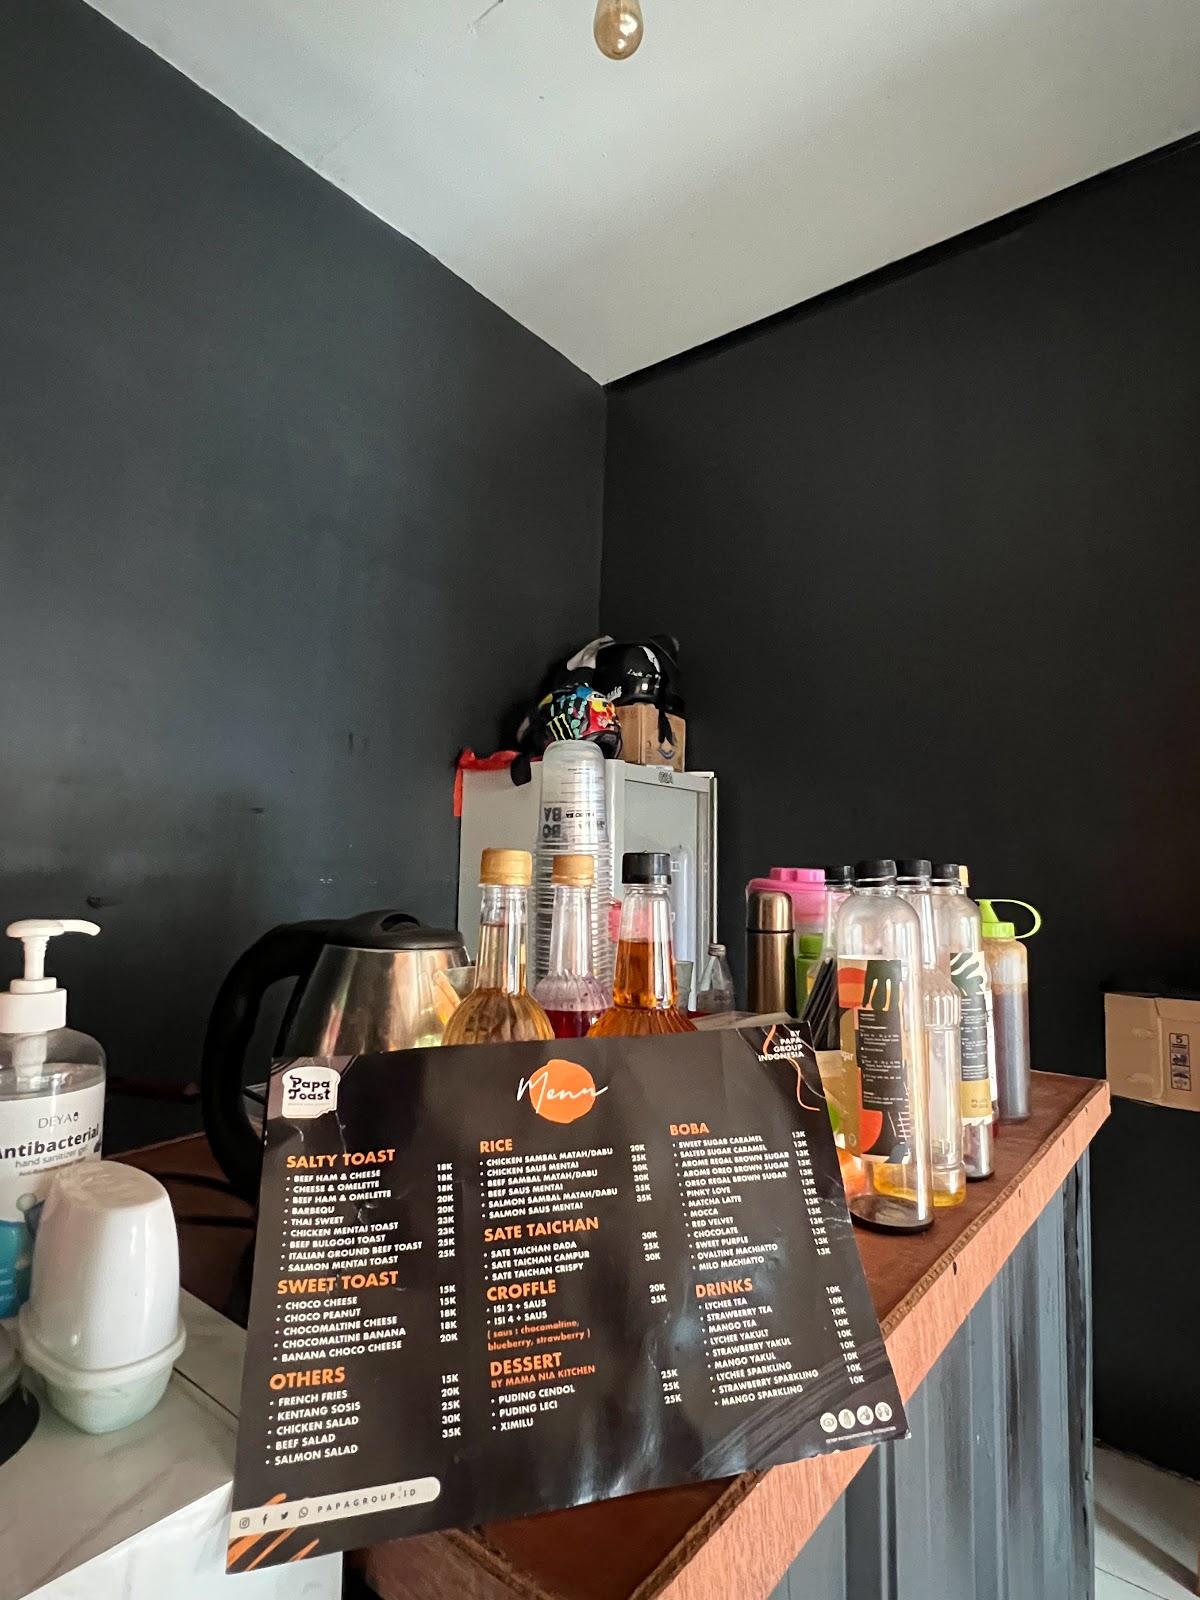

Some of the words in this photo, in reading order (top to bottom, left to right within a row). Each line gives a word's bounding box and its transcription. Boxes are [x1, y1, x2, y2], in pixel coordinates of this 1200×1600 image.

[773, 1044, 802, 1052] GROUP
[758, 1051, 804, 1061] INDONESIA
[290, 1075, 330, 1092] Papa
[288, 1088, 330, 1100] Toast
[517, 1072, 608, 1114] Menu
[38, 1114, 72, 1128] DEYA
[670, 1123, 709, 1136] BOBA
[0, 1123, 99, 1159] ntibacterial
[480, 1139, 513, 1153] RICE
[287, 1154, 337, 1168] SALTY
[343, 1149, 395, 1166] TOAST
[486, 1157, 522, 1166] CHICKEN
[525, 1154, 557, 1164] SAMBAL
[559, 1148, 613, 1160] MATAH/DABU
[680, 1150, 705, 1158] SALTED
[707, 1148, 732, 1156] SUGAR
[733, 1145, 767, 1153] CARAMEL
[350, 1170, 381, 1179] CHEESE
[338, 1181, 379, 1191] OMELETTE
[687, 1189, 710, 1197] PINKY
[712, 1187, 730, 1195] LOVE
[689, 1198, 720, 1207] MATCHA
[722, 1196, 741, 1204] LATTE
[292, 1206, 335, 1214] BARBEQU
[489, 1209, 526, 1218] SALMON
[528, 1205, 550, 1213] SAUS
[552, 1202, 583, 1211] MENTAI
[690, 1209, 718, 1217] MOCCA
[315, 1216, 344, 1224] SWEET
[709, 1217, 733, 1226] VELVET
[334, 1225, 368, 1235] MENTAI
[370, 1222, 398, 1232] TOAST
[484, 1225, 522, 1242] SATE
[527, 1217, 599, 1236] TAICHAN
[694, 1227, 738, 1238] CHOCOLATE
[313, 1238, 355, 1247] BULGOGI
[358, 1235, 386, 1244] TOAST
[438, 1238, 455, 1247] 25K
[696, 1241, 720, 1249] SWEET
[721, 1236, 748, 1246] PURPLE
[289, 1252, 324, 1260] ITALIAN
[328, 1248, 369, 1258] GROUND
[372, 1246, 392, 1254] BEEF
[394, 1242, 422, 1251] TOAST
[438, 1250, 455, 1258] 25K
[697, 1248, 734, 1260] OVALTINE
[736, 1244, 778, 1255] MACHIATTO
[817, 1248, 831, 1256] 13K
[288, 1263, 329, 1272] SALMON
[332, 1260, 367, 1269] MENTAI
[370, 1256, 398, 1265] TOAST
[492, 1260, 511, 1269] SATE
[514, 1256, 551, 1267] TAICHAN
[554, 1251, 590, 1261] CAMPUR
[699, 1262, 719, 1270] MILO
[721, 1256, 764, 1268] MACHIATTO
[492, 1272, 512, 1281] SATE
[514, 1266, 552, 1278] TAICHAN
[555, 1262, 583, 1273] CRISPY
[278, 1277, 336, 1295] SWEET
[342, 1271, 398, 1289] TOAST
[440, 1285, 456, 1294] 15K
[487, 1279, 556, 1301] CROFFLE
[649, 1283, 665, 1293] 20K
[696, 1278, 753, 1298] DRINKS
[826, 1286, 840, 1294] 10K
[286, 1300, 321, 1310] CHOCO
[324, 1297, 358, 1307] CHEESE
[493, 1304, 505, 1313] ISI
[524, 1299, 546, 1309] SAUS
[651, 1295, 667, 1304] 35K
[705, 1300, 731, 1310] LYCHEE
[734, 1298, 747, 1306] TEA
[829, 1296, 843, 1305] 10K
[284, 1313, 320, 1323] CHOCO
[323, 1308, 361, 1319] PEANUT
[494, 1316, 506, 1325] ISI
[524, 1311, 547, 1320] SAUS
[707, 1308, 757, 1321] STRAWBERRY
[759, 1306, 772, 1314] TEA
[284, 1321, 361, 1335] CHOCOMALTINE
[364, 1316, 397, 1328] CHEESE
[521, 1320, 579, 1334] chocomaltine,
[709, 1323, 741, 1333] MANGO
[744, 1320, 757, 1328] TEA
[834, 1318, 849, 1327] 10K
[283, 1334, 360, 1348] CHOCOMALTINE
[363, 1328, 406, 1340] BANANA
[440, 1334, 458, 1343] 20K
[710, 1335, 738, 1345] LYCHEE
[740, 1329, 768, 1340] YAKULT
[837, 1329, 852, 1338] 10K
[488, 1339, 534, 1351] blueberry,
[536, 1331, 584, 1344] strawberry
[713, 1343, 763, 1357] STRAWBERRY
[765, 1338, 792, 1348] YAKUL
[282, 1350, 326, 1362] BANANA
[329, 1346, 365, 1357] CHOCO
[368, 1341, 402, 1352] CHEESE
[490, 1352, 562, 1377] DESSERT
[715, 1358, 748, 1369] MANGO
[749, 1352, 776, 1363] YAKUL
[491, 1380, 503, 1389] BY
[505, 1375, 536, 1386] MAMA
[538, 1372, 555, 1381] NIA
[558, 1365, 595, 1378] KITCHEN
[661, 1369, 678, 1379] 25K
[716, 1370, 745, 1381] LYCHEE
[747, 1361, 792, 1376] SPARKLING
[270, 1367, 345, 1390] OTHERS
[442, 1374, 459, 1384] 15K
[719, 1379, 771, 1394] STRAWBERRY
[774, 1370, 819, 1384] SPARKLING
[441, 1387, 460, 1397] 20K
[663, 1382, 679, 1391] 25K
[279, 1393, 318, 1406] FRENCH
[321, 1390, 347, 1400] FRIES
[499, 1392, 536, 1404] PUDING
[539, 1385, 575, 1398] CENDOL
[664, 1394, 682, 1404] 25K
[722, 1395, 755, 1406] MANGO
[758, 1385, 803, 1400] SPARKLING
[278, 1407, 328, 1421] KENTANG
[331, 1401, 361, 1413] SOSIS
[442, 1401, 460, 1410] 25K
[499, 1405, 537, 1417] PUDING
[539, 1400, 557, 1410] LECI
[442, 1413, 461, 1424] 30K
[501, 1418, 533, 1431] XIMILU
[276, 1422, 322, 1436] CHICKEN
[326, 1416, 359, 1429] SALAD
[442, 1427, 461, 1438] 35K
[275, 1439, 299, 1451] BEEF
[302, 1434, 336, 1447] SALAD
[275, 1451, 321, 1465] SALMON
[324, 1445, 358, 1458] SALAD
[318, 1488, 416, 1514] PAPAGROUP.ID
